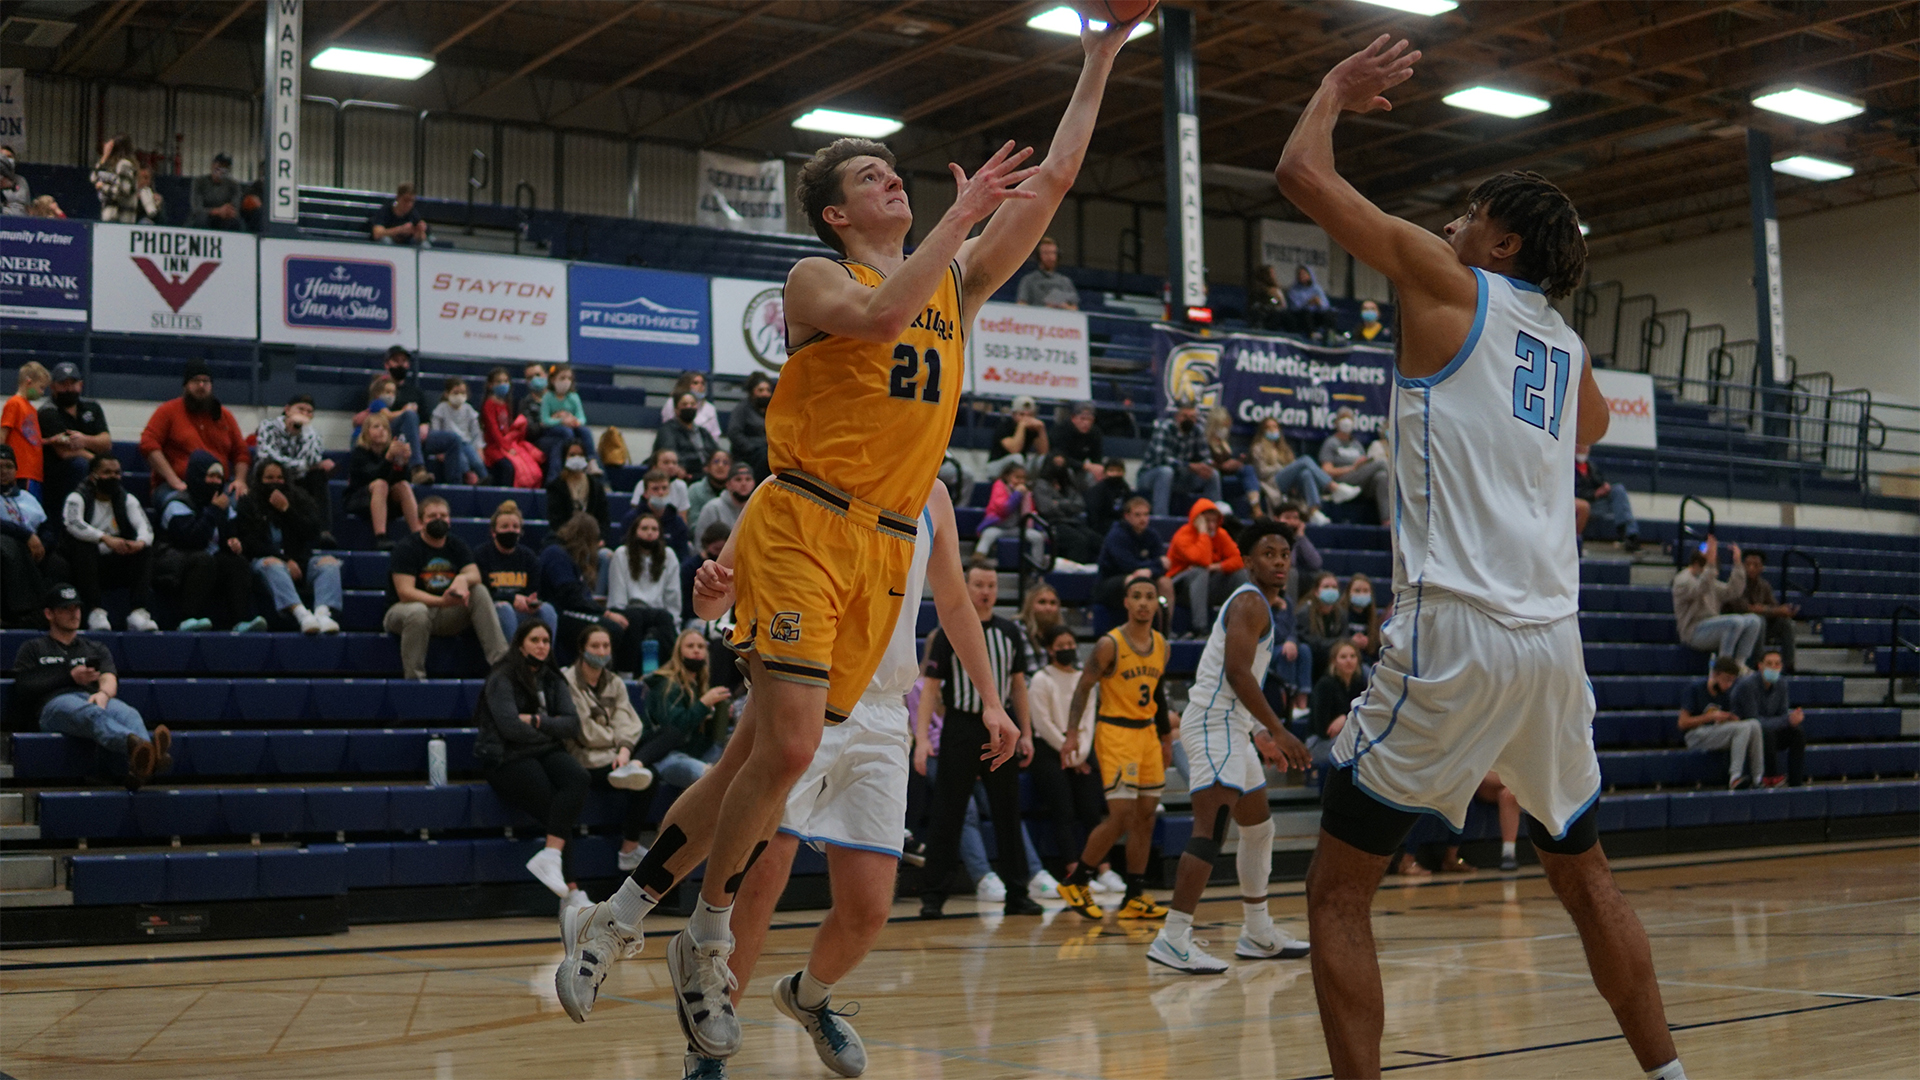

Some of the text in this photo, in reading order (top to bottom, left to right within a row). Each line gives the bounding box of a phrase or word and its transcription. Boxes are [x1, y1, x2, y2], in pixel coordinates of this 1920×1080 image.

[279, 0, 297, 206] WARRIORS
[1181, 127, 1199, 297] FANATICS
[36, 231, 74, 246] Partner
[130, 230, 222, 259] PHOENIX
[163, 257, 189, 272] INN
[28, 273, 79, 290] BANK
[294, 277, 381, 302] Hampton
[432, 272, 555, 299] STAYTON
[151, 312, 203, 330] SUITES
[290, 299, 335, 319] Inn
[343, 300, 389, 321] Suites
[439, 301, 548, 326] SPORTS
[580, 310, 699, 330] PT NORTHWEST
[980, 317, 1082, 341] tedferry.com
[984, 343, 1078, 365] 503-370-7716
[1235, 348, 1308, 378] Athletic
[888, 342, 942, 405] 21
[1513, 329, 1571, 442] 21
[1138, 684, 1151, 707] 3
